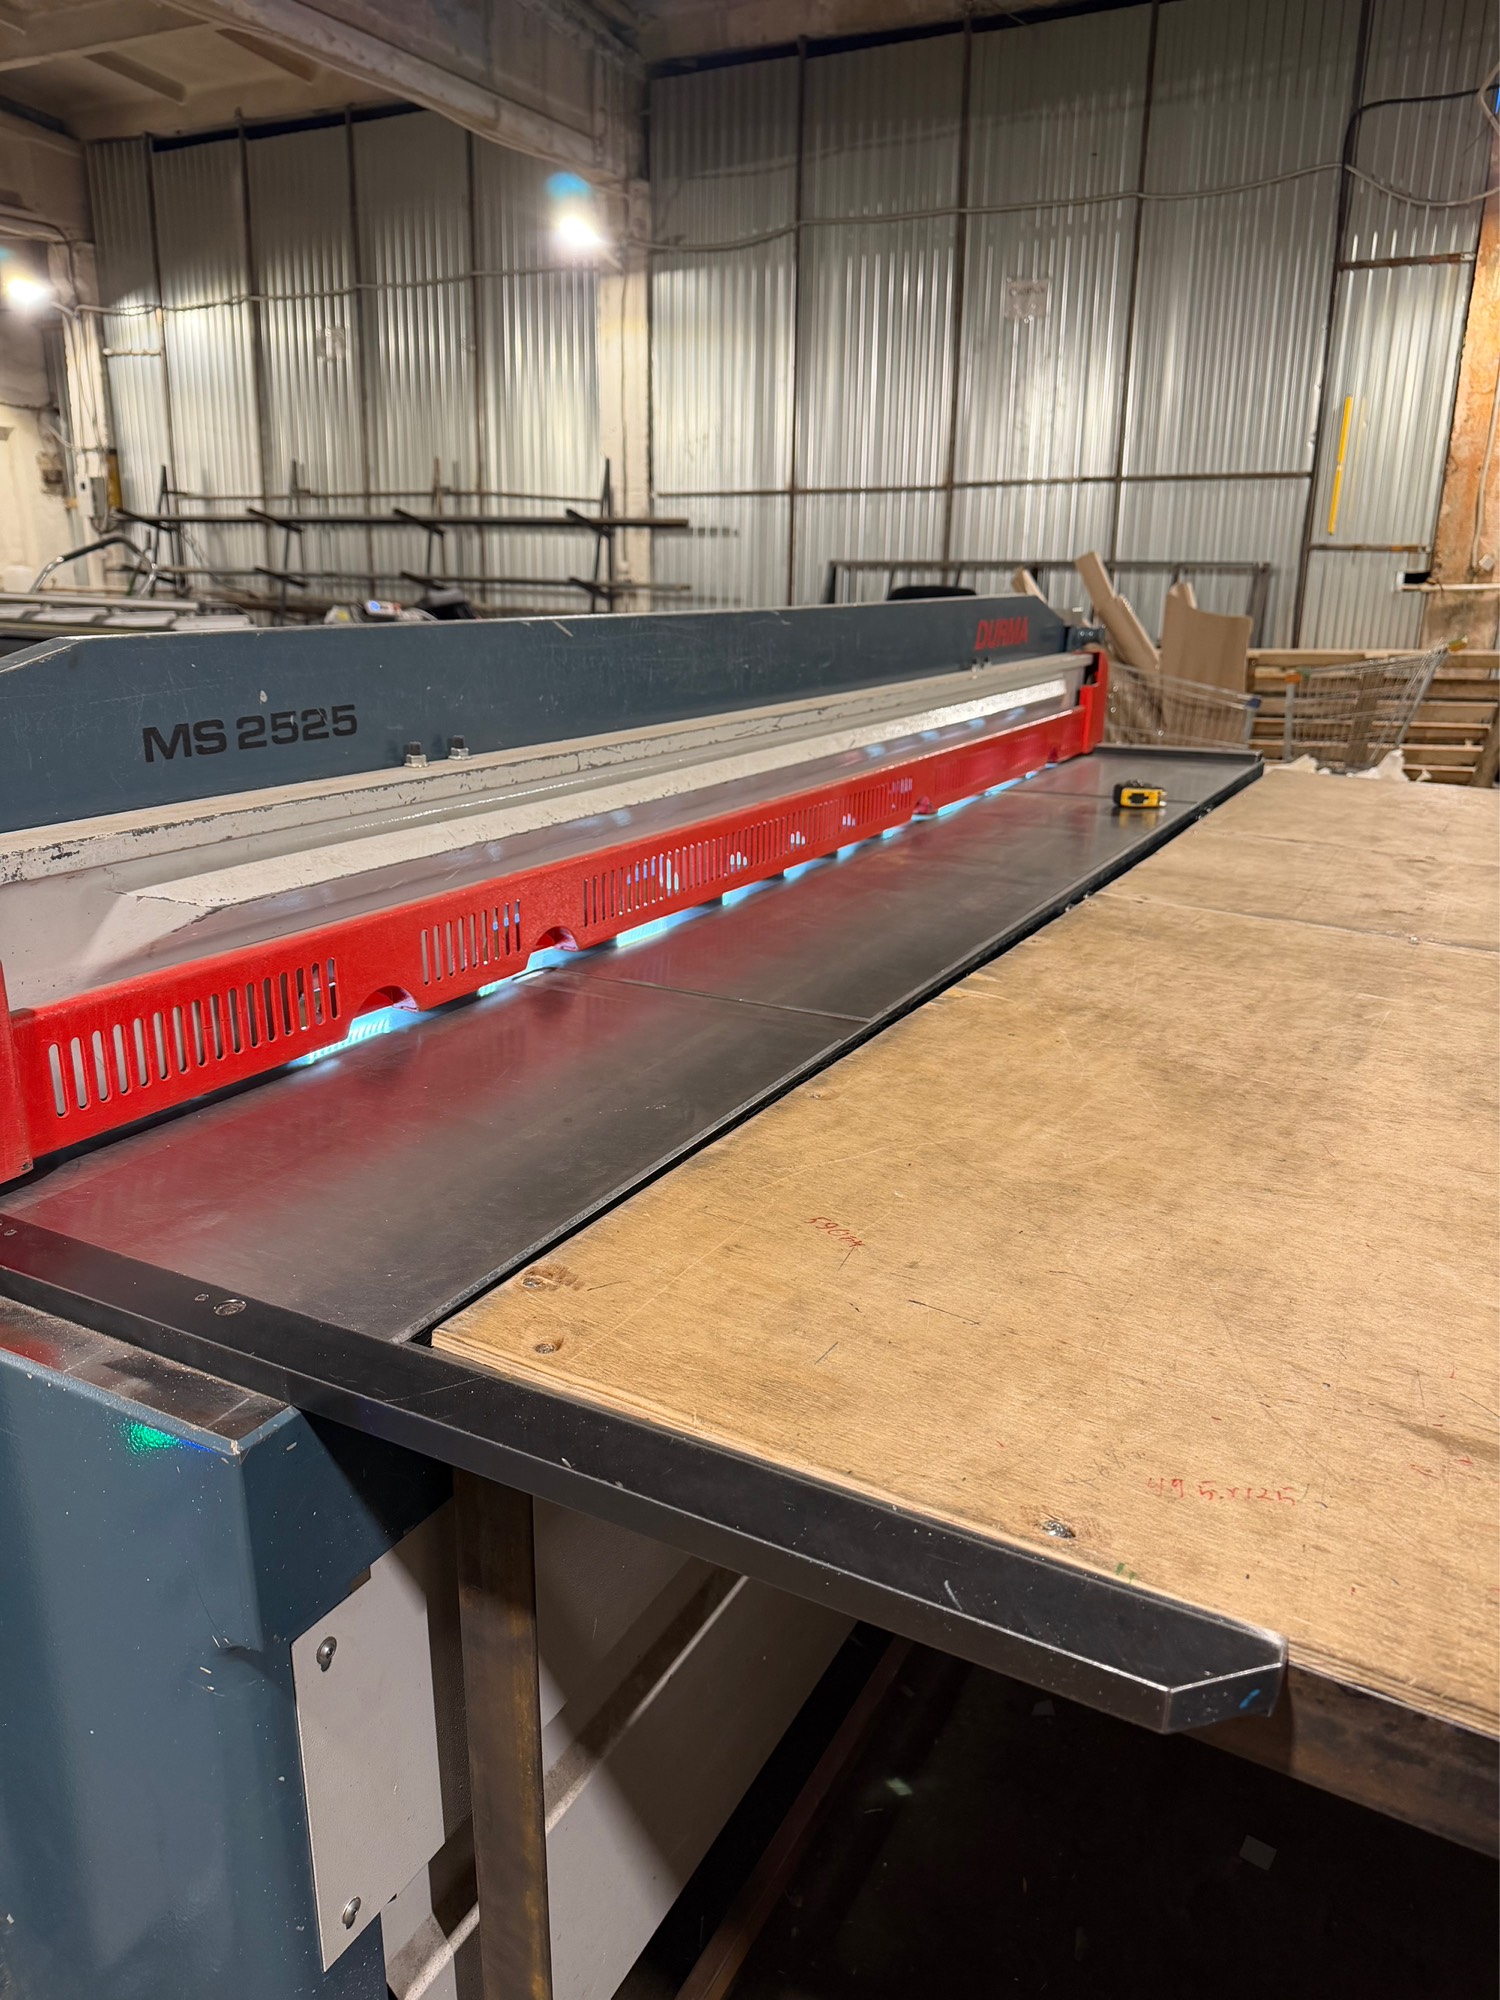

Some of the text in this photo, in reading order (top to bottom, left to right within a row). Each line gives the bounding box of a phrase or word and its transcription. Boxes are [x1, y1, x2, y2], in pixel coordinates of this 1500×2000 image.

[974, 616, 1030, 651] DURMA
[142, 704, 358, 763] MS 2525
